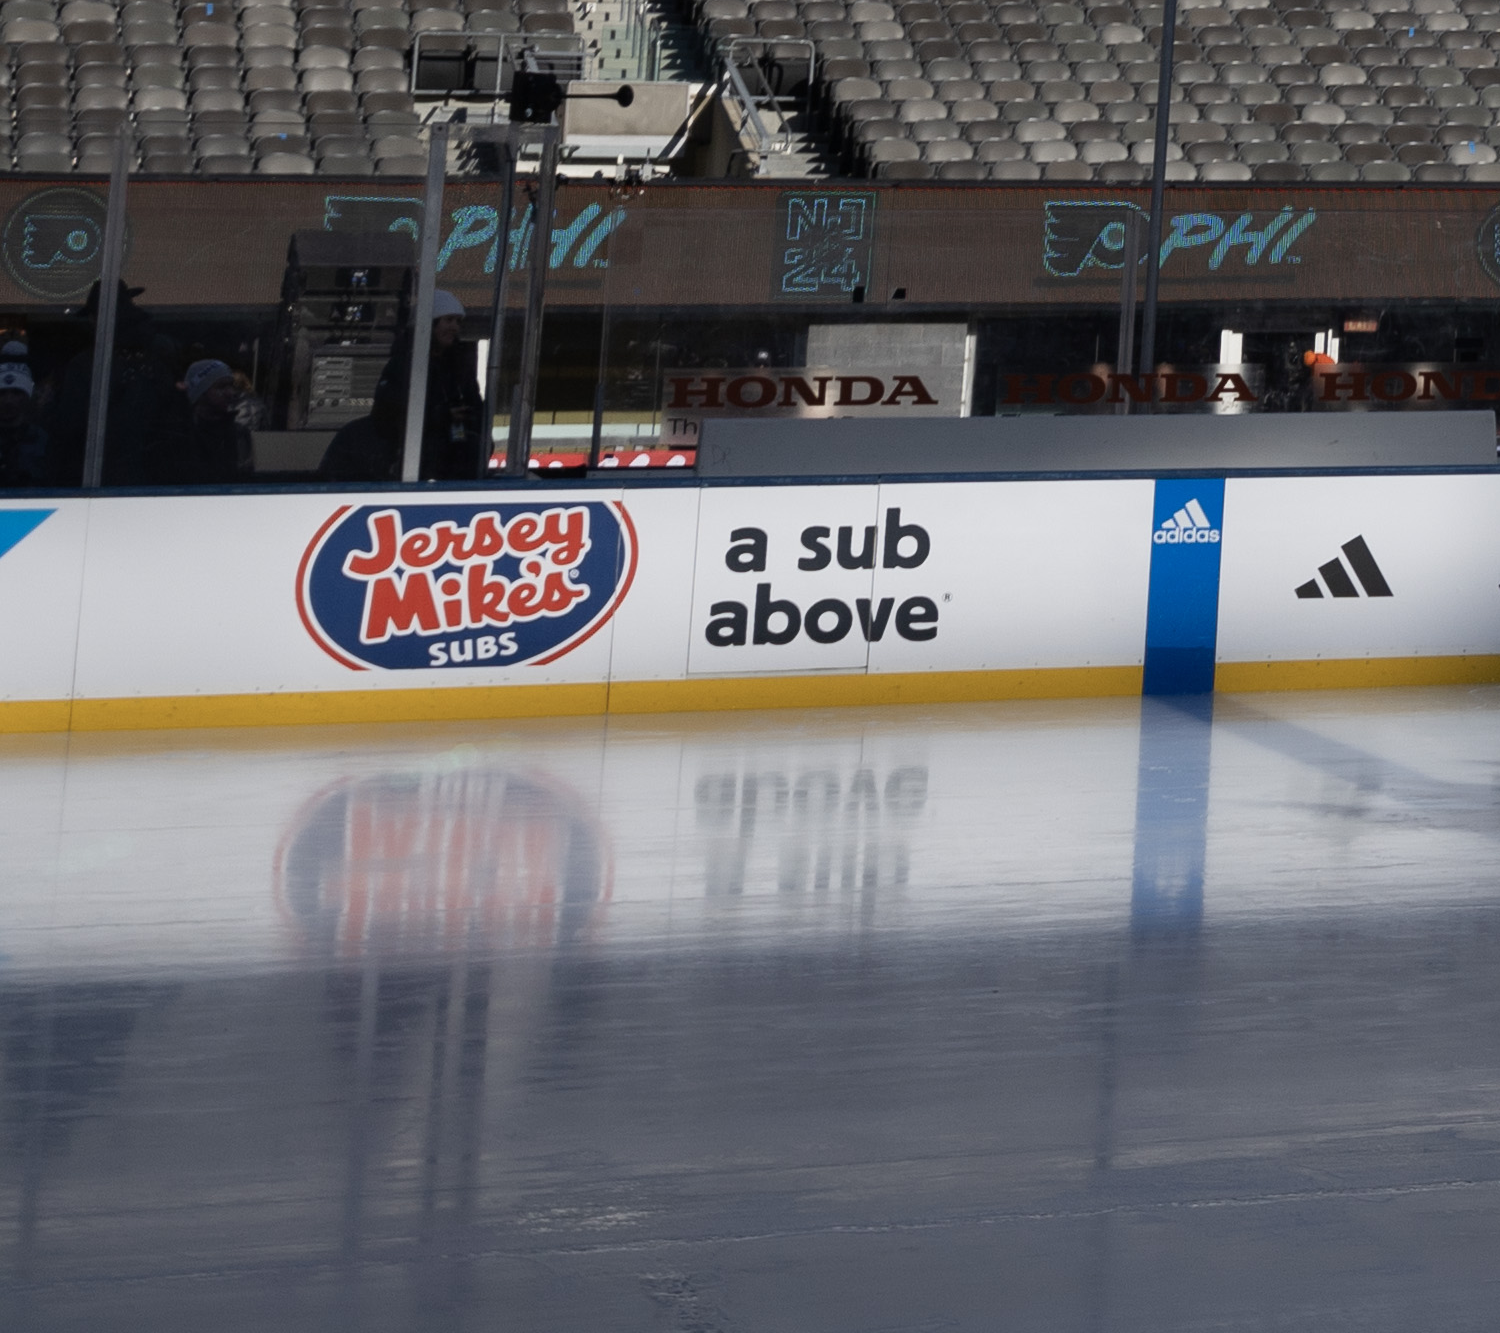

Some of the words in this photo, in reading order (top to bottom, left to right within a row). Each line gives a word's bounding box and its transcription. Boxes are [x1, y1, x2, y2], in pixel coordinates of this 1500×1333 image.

[1159, 204, 1318, 271] PHI
[781, 247, 862, 293] 24
[667, 375, 939, 409] HONDA
[1001, 373, 1259, 405] HONDA
[346, 506, 590, 579] Jersey
[724, 526, 769, 574] a
[797, 507, 932, 572] sub
[1152, 527, 1220, 544] adidas
[362, 549, 589, 643] Mike's
[704, 582, 940, 648] above
[428, 632, 519, 668] SUBS
